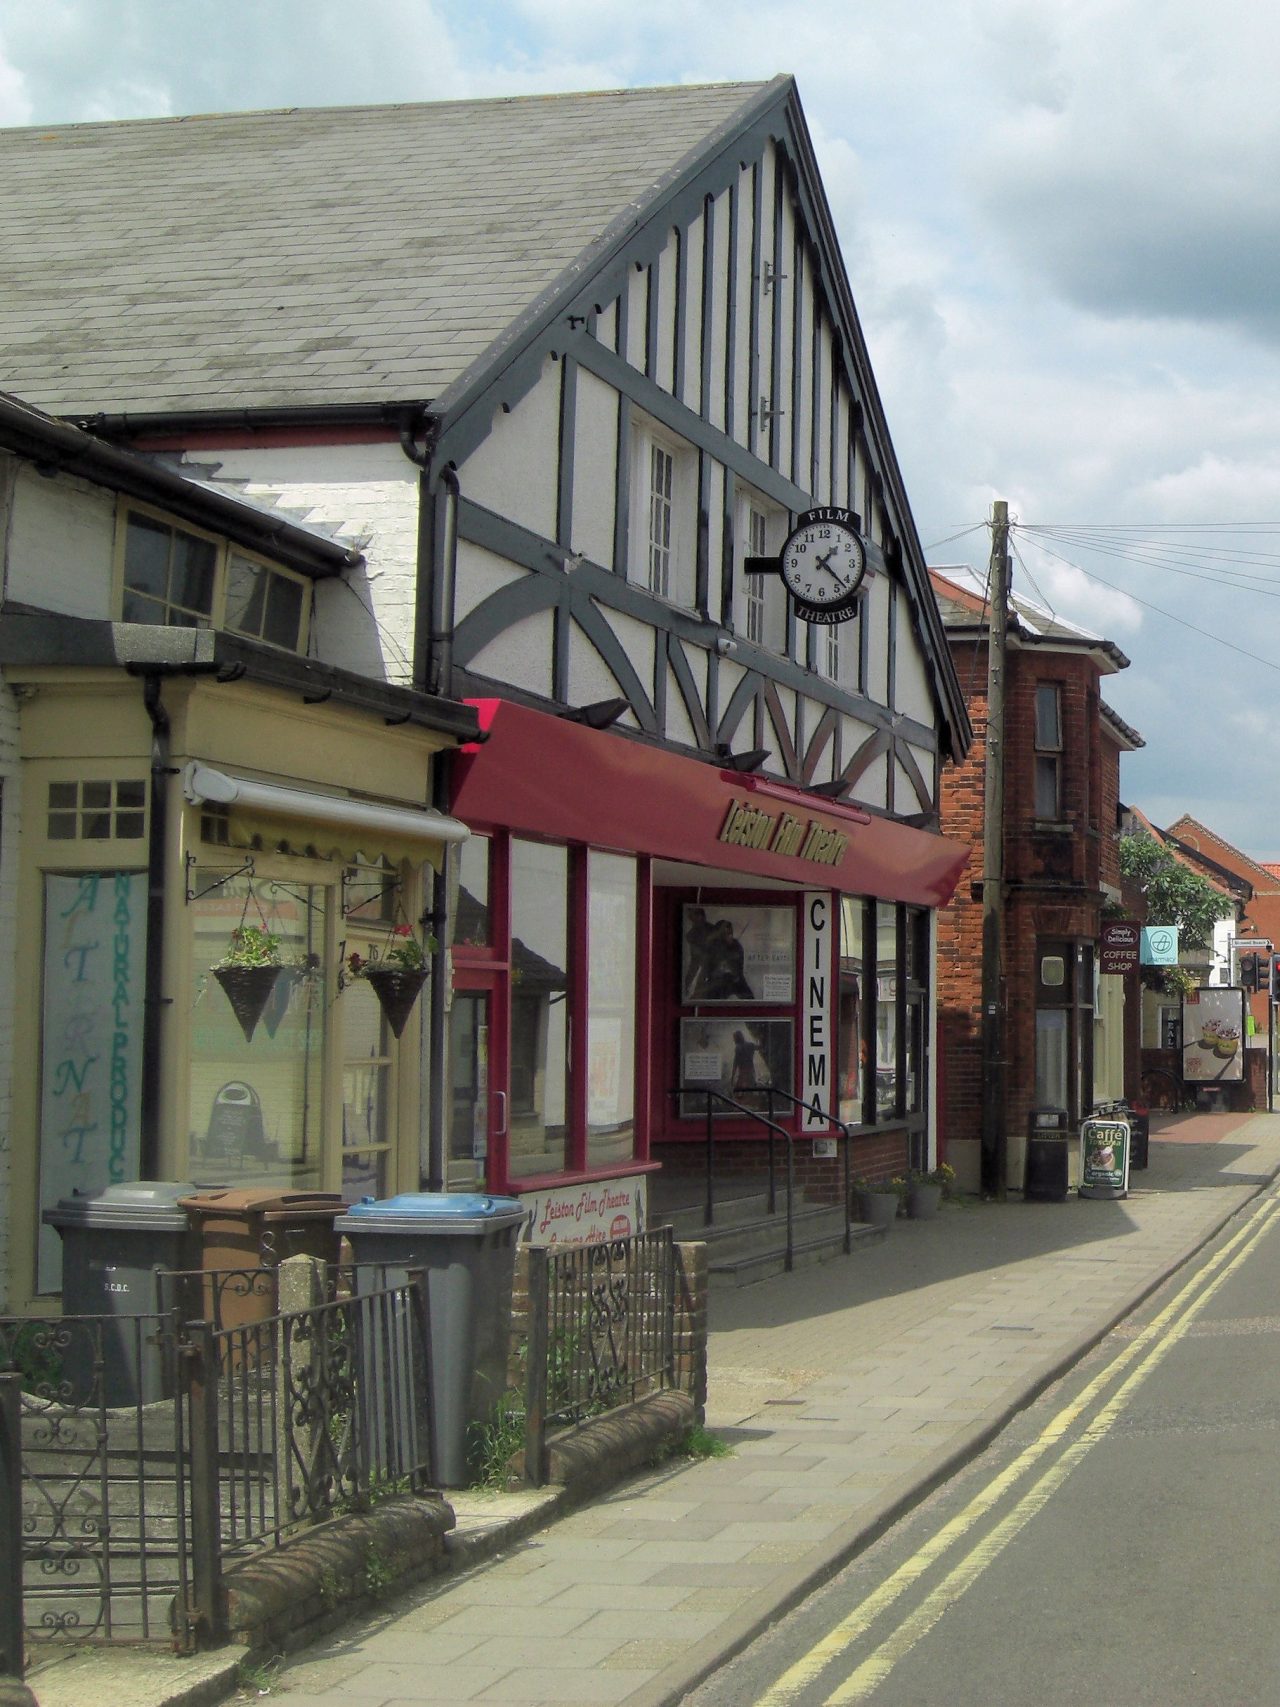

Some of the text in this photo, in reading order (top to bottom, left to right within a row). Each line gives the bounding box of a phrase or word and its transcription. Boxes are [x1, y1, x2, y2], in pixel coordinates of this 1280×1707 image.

[808, 509, 849, 522] FILM
[804, 534, 814, 543] 11
[818, 529, 831, 539] 12
[795, 544, 806, 553] 10
[844, 543, 852, 552] 2
[791, 559, 798, 568] 9
[848, 559, 855, 568] 3
[794, 574, 801, 583] 8
[843, 574, 850, 583] 4
[805, 584, 812, 593] 7
[818, 588, 825, 597] 6
[833, 584, 840, 593] 5
[797, 606, 855, 623] THEATRE
[719, 799, 777, 851] Leiston
[769, 812, 804, 857] Film
[112, 872, 131, 1028] NATURAL
[1103, 950, 1137, 960] COFFEE
[1107, 962, 1133, 971] SHOP
[807, 899, 826, 1126] CINEMA
[108, 1031, 129, 1184] PRODUC
[1088, 1128, 1123, 1142] Caffé
[540, 1188, 630, 1234] Leiston Film Theatre
